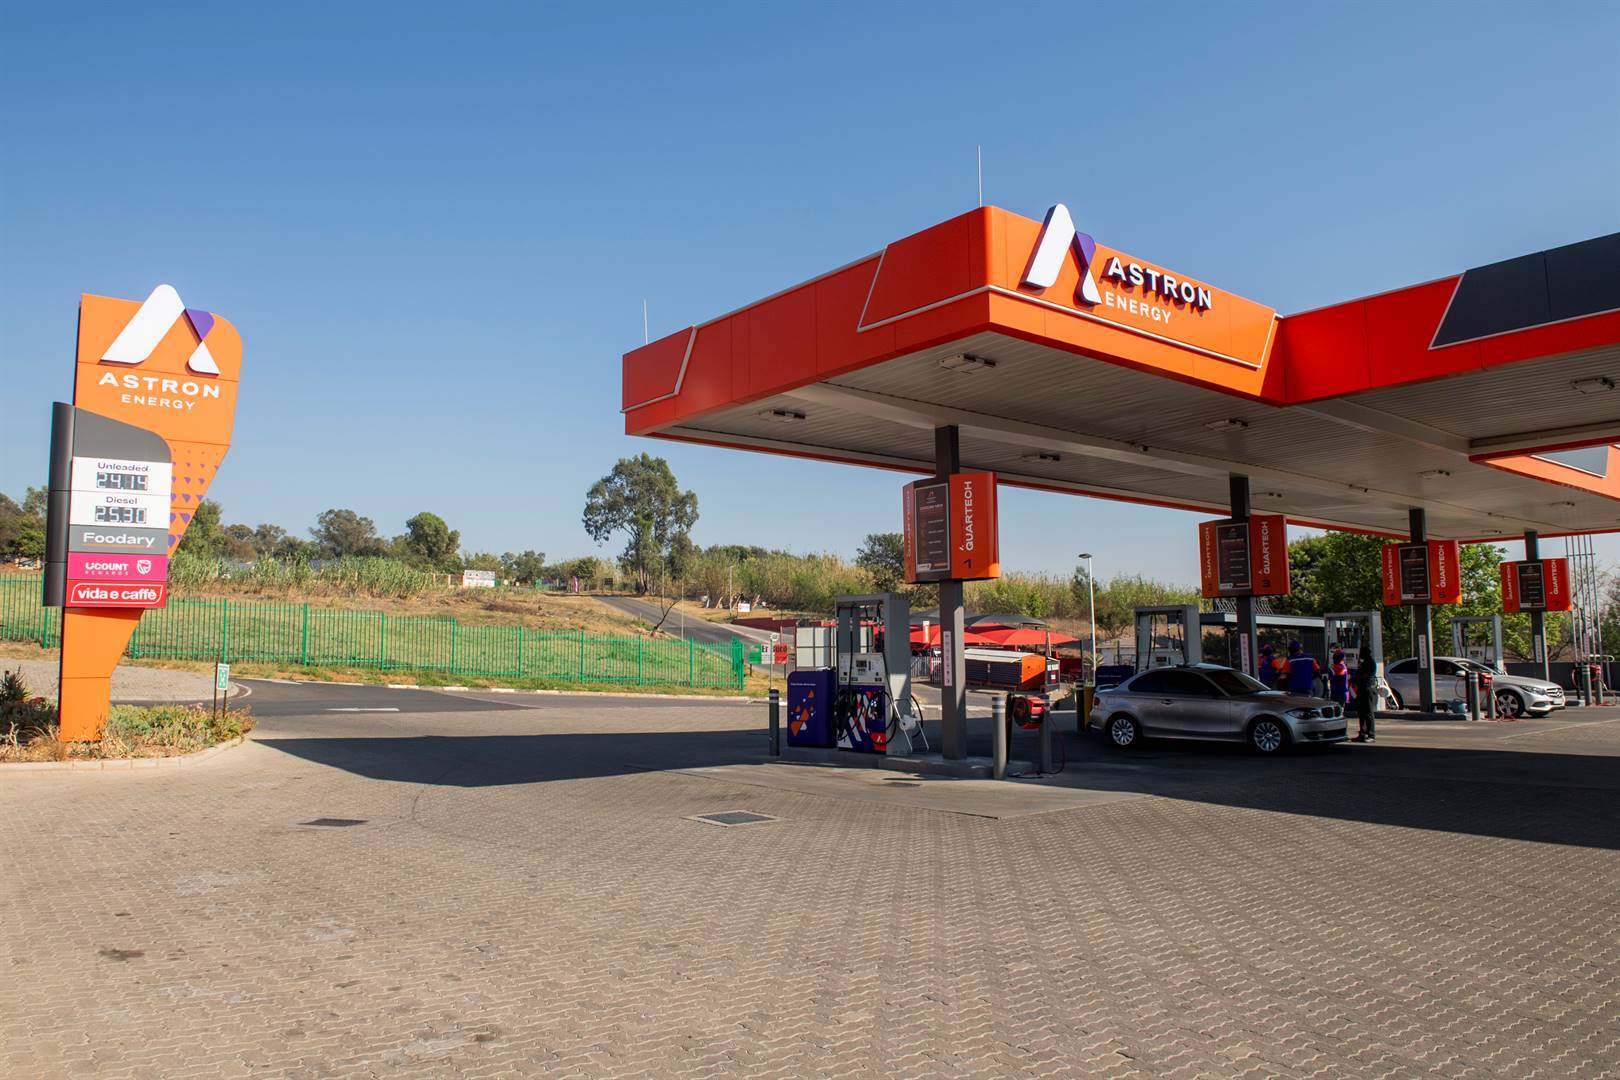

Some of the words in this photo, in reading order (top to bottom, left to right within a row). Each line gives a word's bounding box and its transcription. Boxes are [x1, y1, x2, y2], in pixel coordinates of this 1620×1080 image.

[1105, 257, 1212, 310] ASTRON
[1105, 292, 1172, 324] ENERGY
[99, 372, 220, 398] ASTRON
[121, 394, 195, 410] ENERGY
[97, 462, 149, 472] Unleaded
[106, 496, 138, 505] Diesel
[964, 481, 974, 551] QUARTECH
[83, 532, 156, 548] Foodary
[1261, 521, 1271, 575] QUARTECH
[964, 559, 972, 568] 1
[1438, 545, 1447, 588] QUARTECH
[78, 587, 108, 600] vida
[109, 590, 119, 600] e
